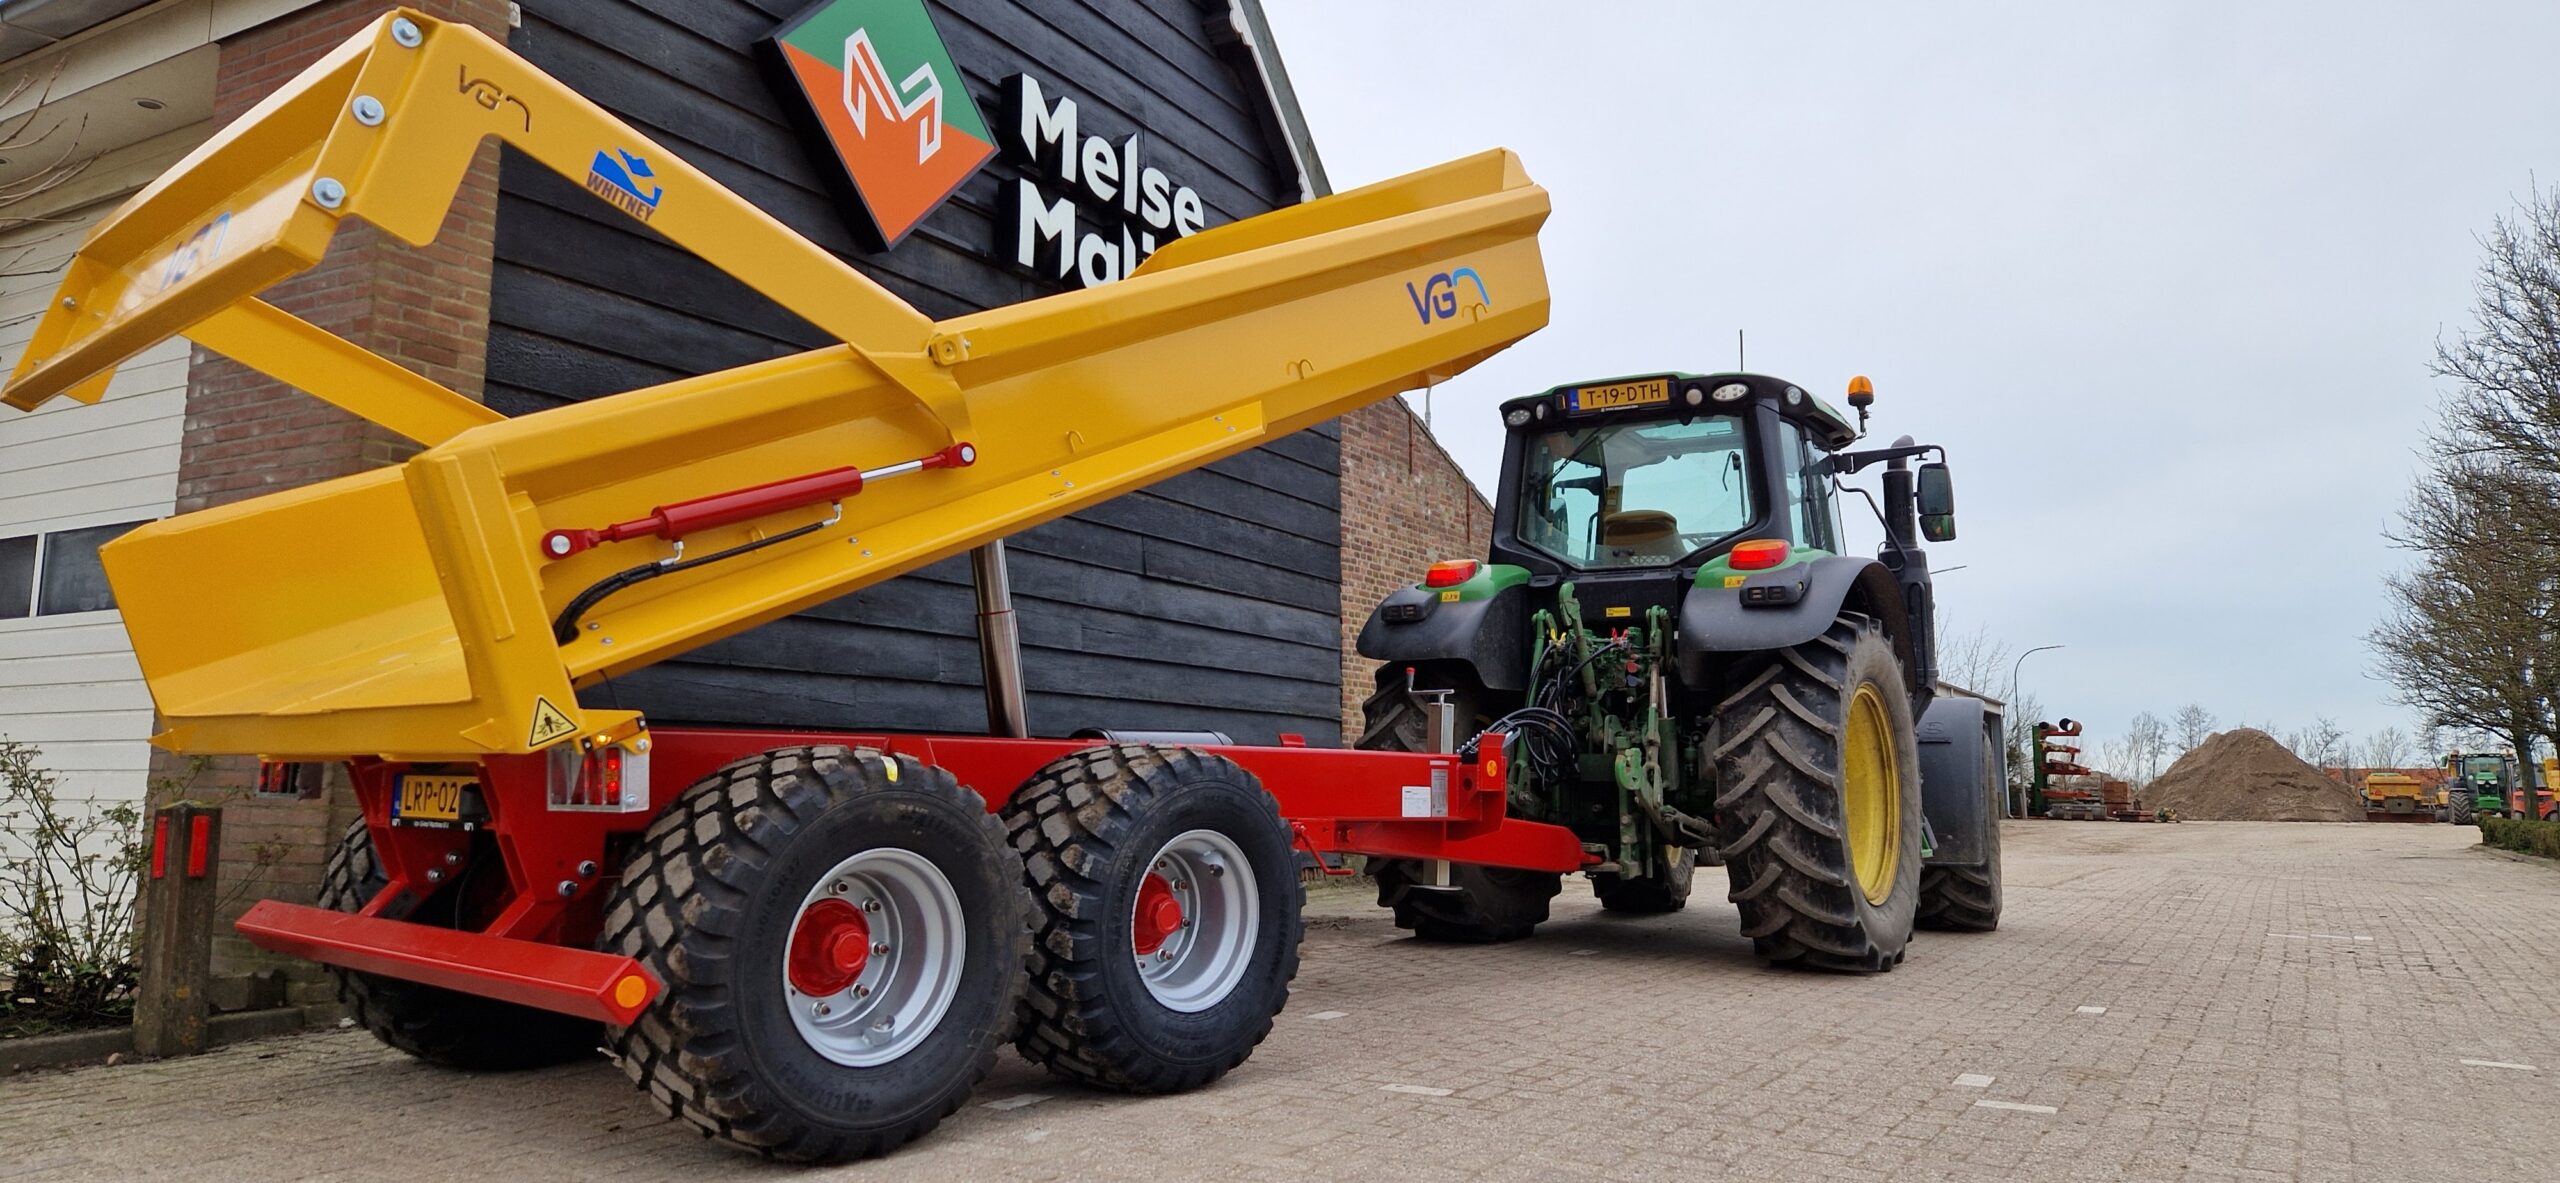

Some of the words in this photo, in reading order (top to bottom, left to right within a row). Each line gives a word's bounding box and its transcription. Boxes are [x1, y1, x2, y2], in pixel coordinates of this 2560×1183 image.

[1020, 72, 1205, 238] Melse
[586, 172, 656, 222] WHITNEY
[1586, 383, 1662, 406] T-19-DTH
[404, 781, 459, 812] LRP-02
